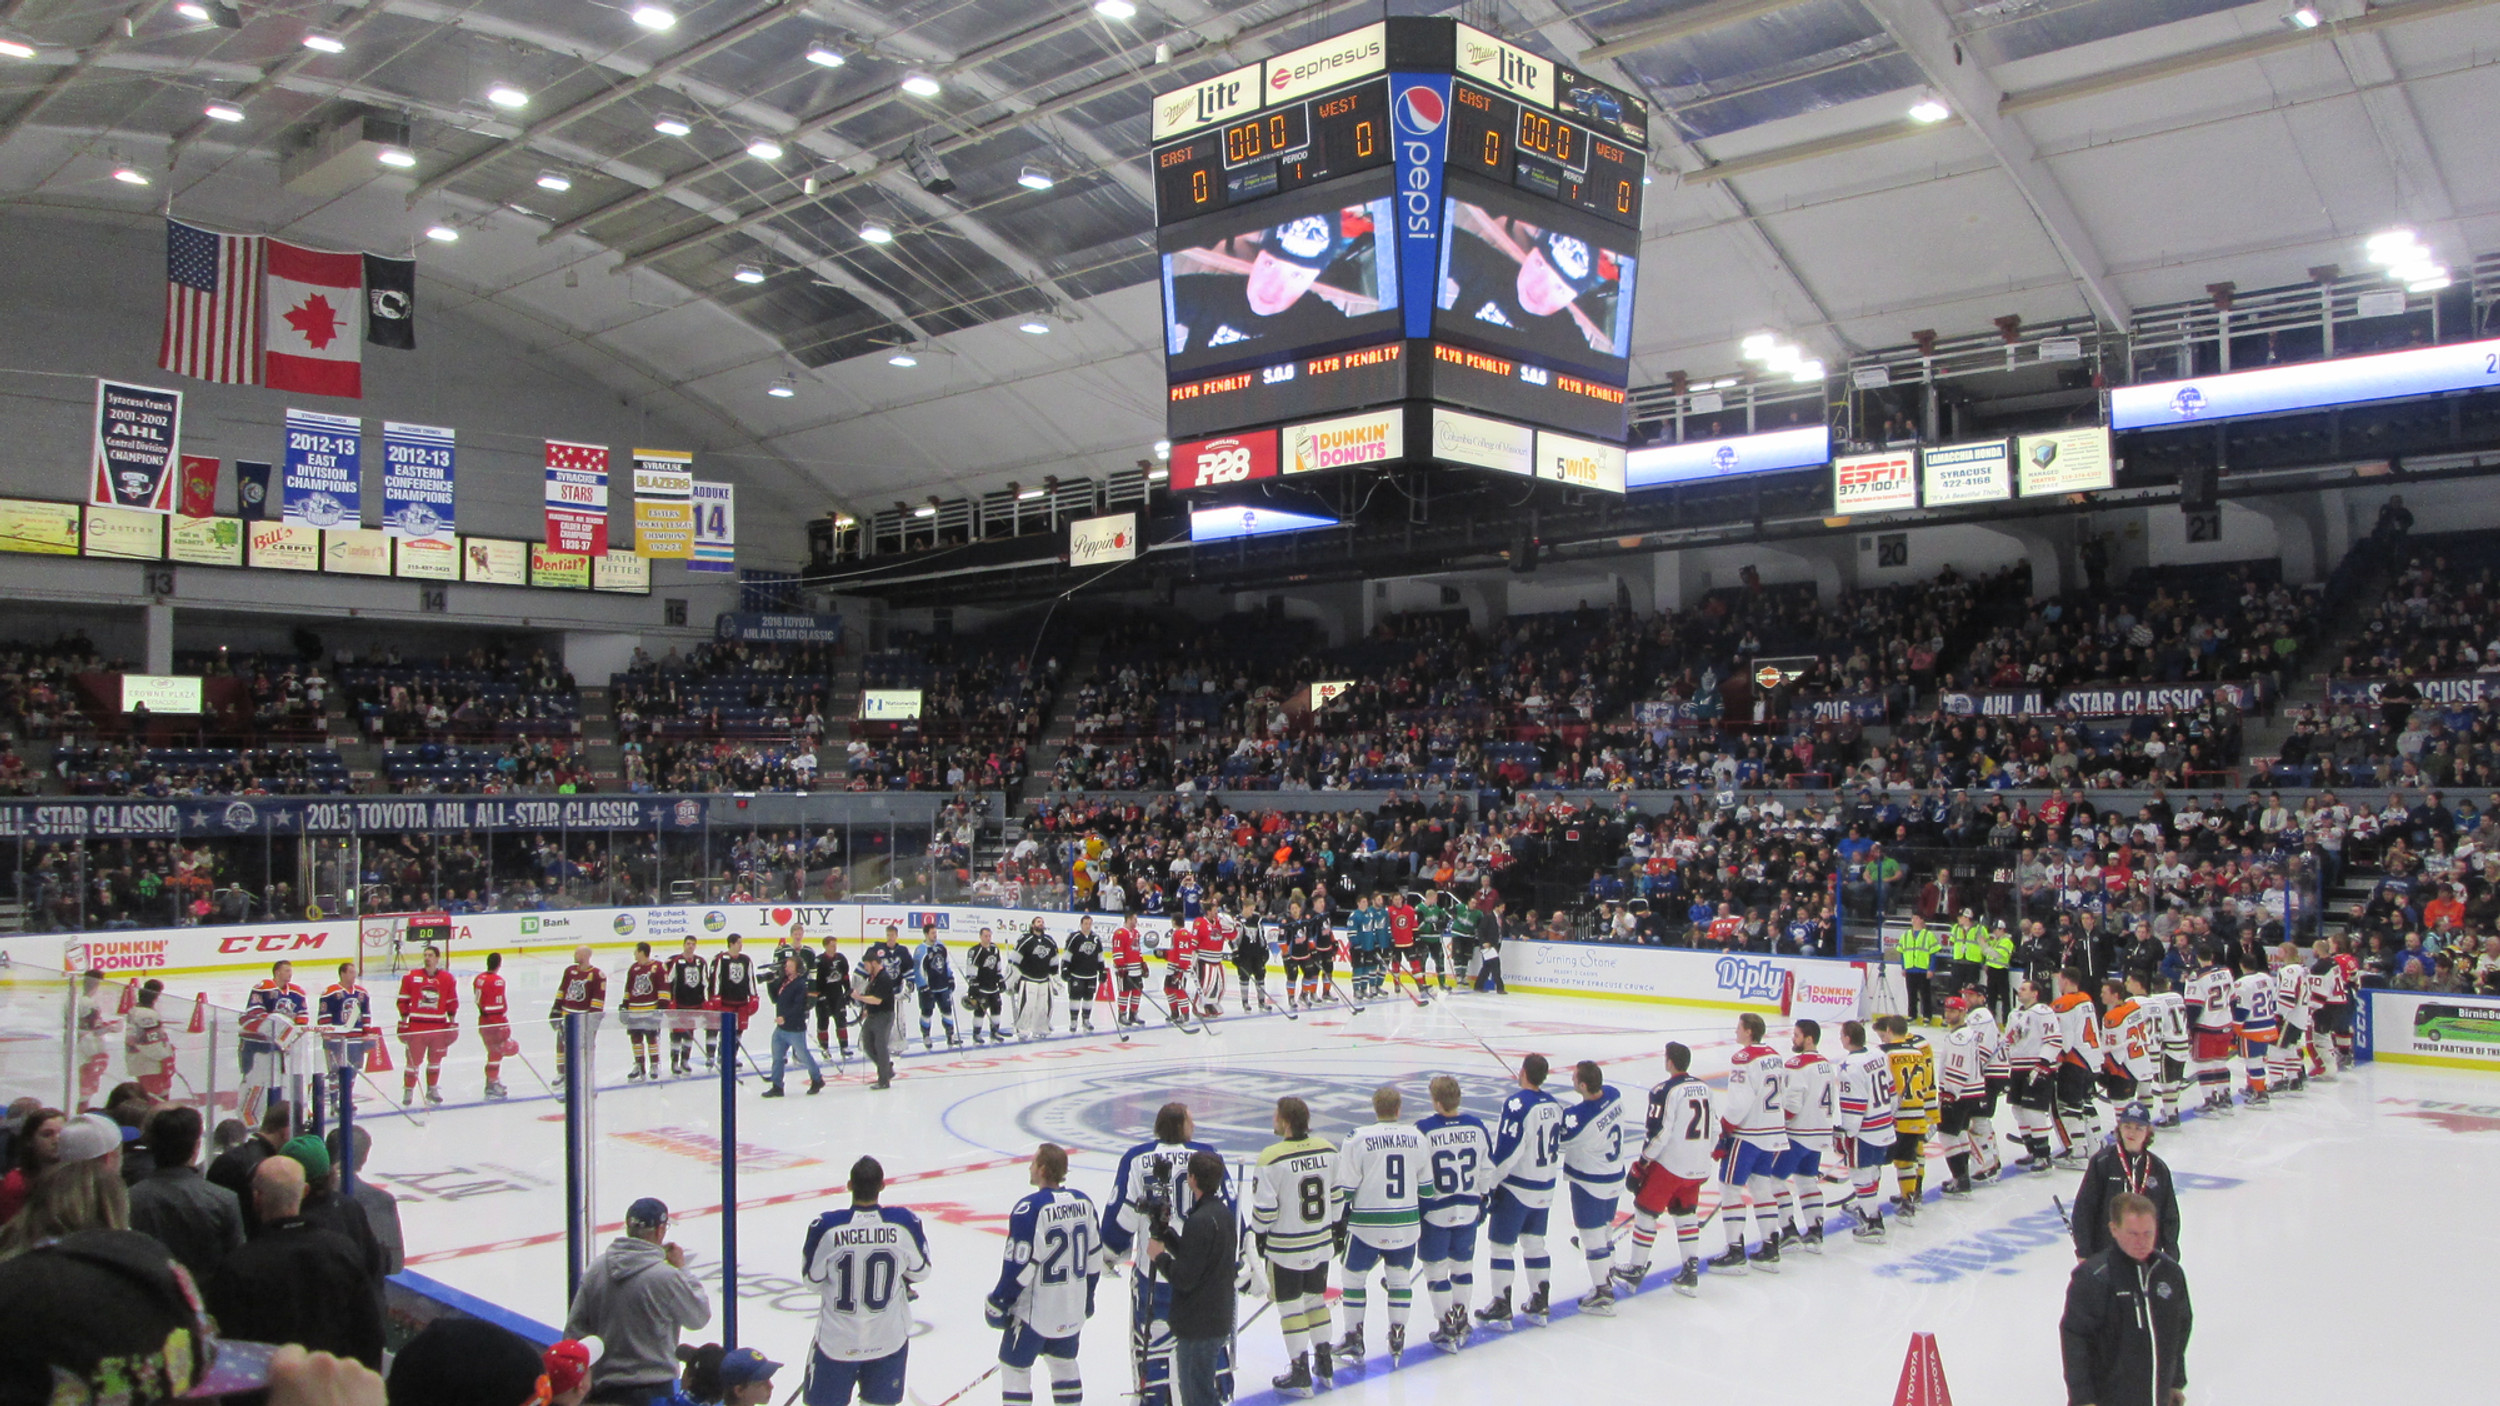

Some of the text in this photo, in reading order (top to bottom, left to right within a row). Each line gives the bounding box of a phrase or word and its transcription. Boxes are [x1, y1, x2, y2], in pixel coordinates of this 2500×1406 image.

[1294, 42, 1380, 79] ephesus
[1466, 42, 1537, 89] Miller Lite
[1163, 81, 1240, 127] Miller Lite
[1319, 96, 1357, 118] WEST
[1459, 88, 1491, 112] EAST
[1356, 121, 1372, 158] 0
[1484, 131, 1499, 166] 0
[1161, 147, 1193, 168] EAST
[1283, 152, 1308, 165] PERIOD
[1596, 142, 1624, 163] WEST
[1193, 170, 1207, 203] 0
[1563, 170, 1583, 184] PERIOD
[1403, 141, 1435, 239] pepsi
[1617, 181, 1629, 213] 0
[1172, 346, 1400, 401] PLYR PENALTY PLYR PENALTY
[1435, 345, 1625, 404] PLYR PENALTY PLYR PENALTY
[108, 392, 172, 412] Syracuse Crunch
[110, 409, 168, 427] 2001-2002
[113, 423, 165, 441] AHL
[1320, 423, 1389, 450] DUNKIN'
[106, 436, 168, 454] Central Division
[290, 433, 355, 456] 2012-13
[1473, 437, 1494, 449] College
[1975, 447, 2002, 459] HONDA
[110, 450, 164, 466] CHAMPIONS
[308, 453, 337, 465] EAST
[388, 445, 450, 467] 2012-13
[1320, 442, 1386, 467] DONUTS
[297, 464, 348, 481] DIVISION
[395, 464, 444, 480] EASTERN
[643, 462, 682, 471] SYRACUSE
[1195, 448, 1251, 486] P28
[1840, 460, 1907, 485] ESPN
[1940, 467, 1992, 479] SYRACUSE
[287, 476, 357, 493] CHAMPIONS
[385, 476, 453, 493] CONFERENCE
[556, 471, 598, 484] SYRACUSE
[637, 475, 690, 489] BLAZERS
[386, 488, 453, 504] CHAMPIONS
[561, 485, 593, 502] STARS
[693, 502, 727, 539] 14
[2190, 516, 2219, 540] 21
[254, 527, 293, 549] Bill's
[272, 544, 312, 552] CARPET
[533, 555, 587, 571] Dentist?
[1880, 542, 1907, 565] 20
[601, 565, 640, 574] FITTER
[147, 573, 171, 594] 13
[423, 591, 445, 611] 14
[667, 606, 686, 624] 15
[784, 616, 815, 628] TOYOTA
[743, 628, 759, 639] AHL
[799, 629, 834, 640] CLASSIC
[1814, 701, 1850, 723] 2016
[2068, 688, 2203, 716] STAR CLASSIC
[93, 805, 178, 833] CLASSIC
[357, 803, 428, 829] TOYOTA
[433, 803, 470, 828] AHL
[475, 802, 560, 827] ALL-STAR
[566, 802, 639, 827] CLASSIC
[523, 918, 570, 931] TD Bank
[648, 910, 662, 918] Hip
[759, 907, 834, 926] I NY
[92, 940, 169, 956] DUNKIN'
[216, 932, 329, 954] CCM
[92, 953, 166, 970] DONUTS
[1536, 946, 1616, 968] Turning Stone
[687, 973, 698, 983] 20
[732, 968, 742, 977] 20
[1503, 973, 1531, 982] OFFICIAL
[1534, 976, 1559, 984] CASINO
[1587, 980, 1622, 989] SYRACUSE
[1624, 983, 1655, 991] CRUNCH
[1717, 958, 1785, 999] Diply
[1813, 985, 1856, 996] DUNKIN'
[2282, 979, 2293, 988] 21
[1812, 995, 1853, 1005] DONUTS
[2208, 983, 2231, 1012] 27
[2083, 1017, 2099, 1048] 4
[2357, 997, 2366, 1049] CCM
[2440, 1045, 2473, 1054] PARTNER
[1840, 1081, 1851, 1093] 16
[1872, 1070, 1889, 1108] 16
[1820, 1081, 1833, 1116] 4
[1597, 1106, 1623, 1132] BRENNAN
[1649, 1103, 1660, 1118] 21
[1685, 1099, 1710, 1140] 21
[1430, 1130, 1477, 1147] NYLANDER
[1502, 1119, 1518, 1138] 14
[1365, 1134, 1418, 1152] SHINKARUK
[1605, 1124, 1622, 1162] 3
[1290, 1156, 1328, 1173] O'NEILL
[1431, 1148, 1477, 1194] 62
[1386, 1153, 1405, 1200] 9
[1299, 1174, 1324, 1224] 8
[1044, 1202, 1088, 1222] TAORMINA
[833, 1228, 899, 1249] ANGELIDIS
[1005, 1238, 1032, 1264] 20
[1040, 1222, 1089, 1286] 20
[833, 1249, 899, 1314] 10
[1907, 1351, 1919, 1400] TOYOTA
[1930, 1351, 1941, 1404] TOYOTA
